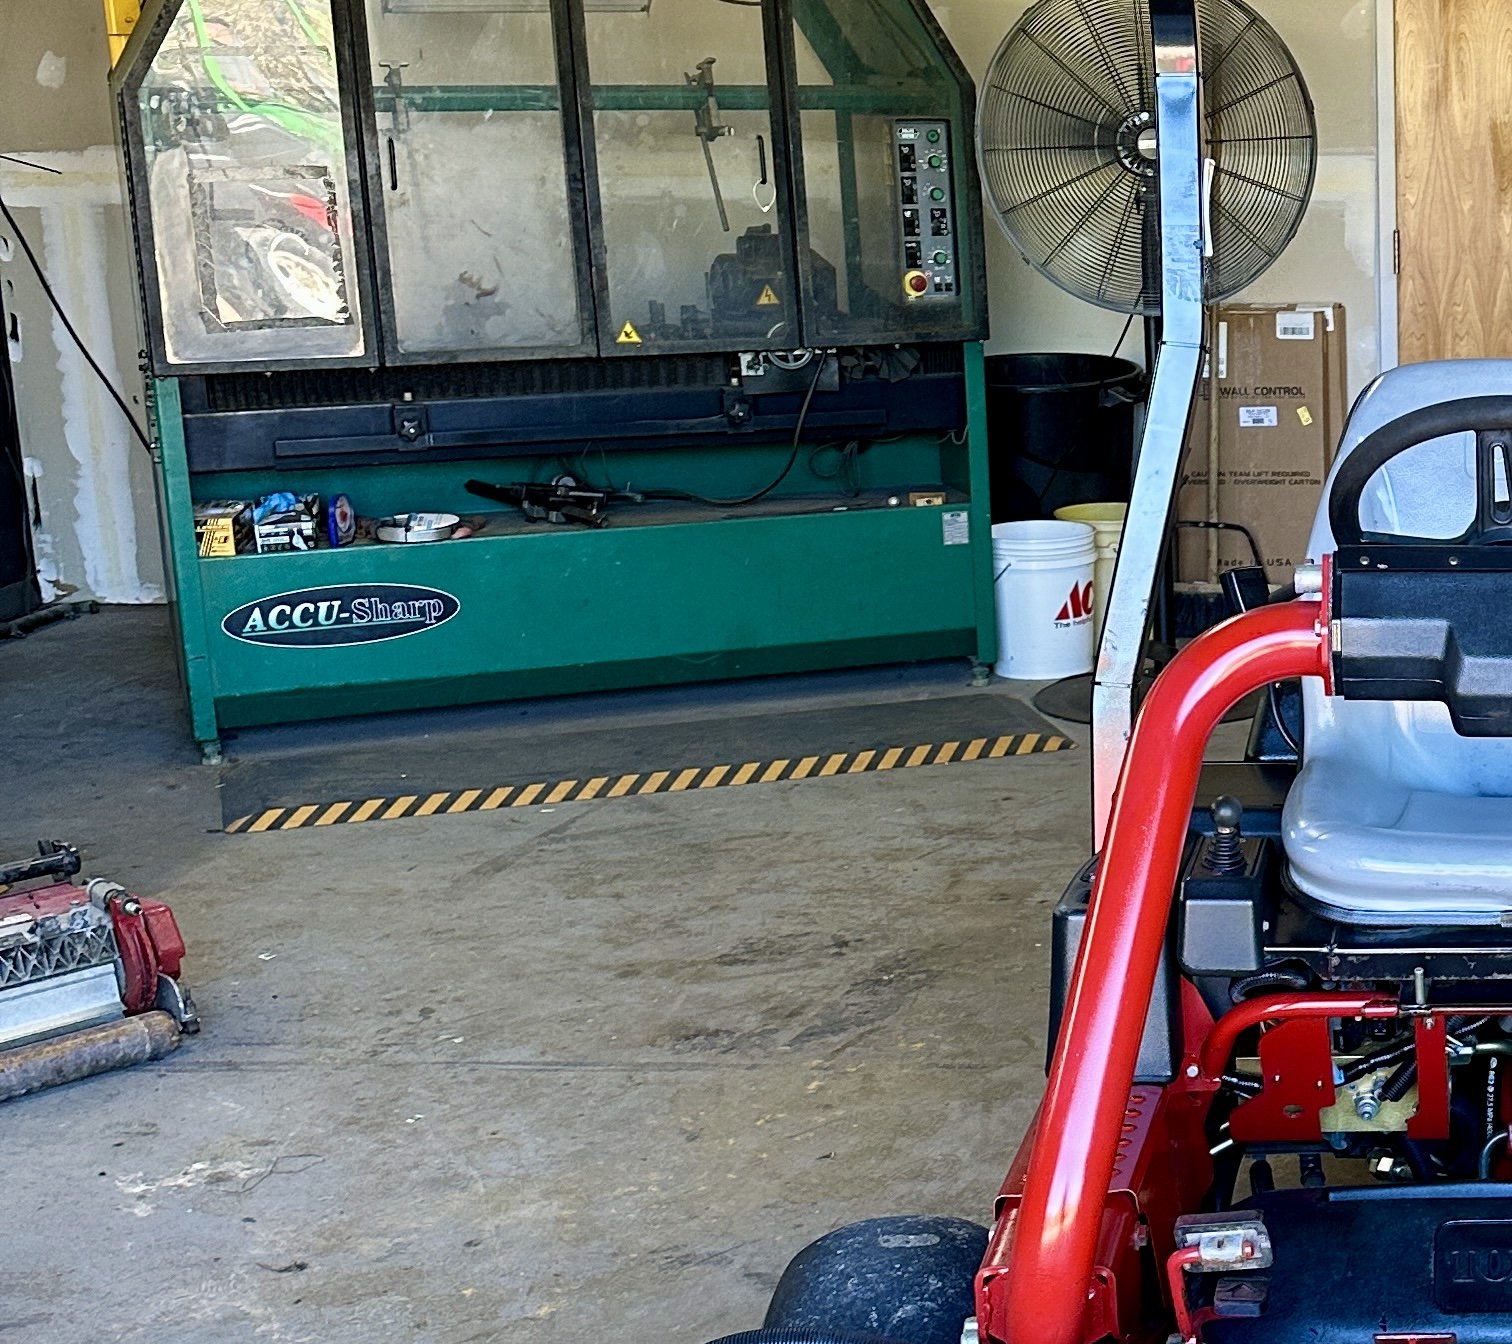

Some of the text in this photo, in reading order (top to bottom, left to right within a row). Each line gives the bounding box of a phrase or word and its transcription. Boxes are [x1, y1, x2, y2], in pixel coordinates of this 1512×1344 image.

[1220, 387, 1305, 396] WALL CONTROL
[1267, 558, 1292, 567] USA
[242, 598, 444, 634] ACCU-Sharp
